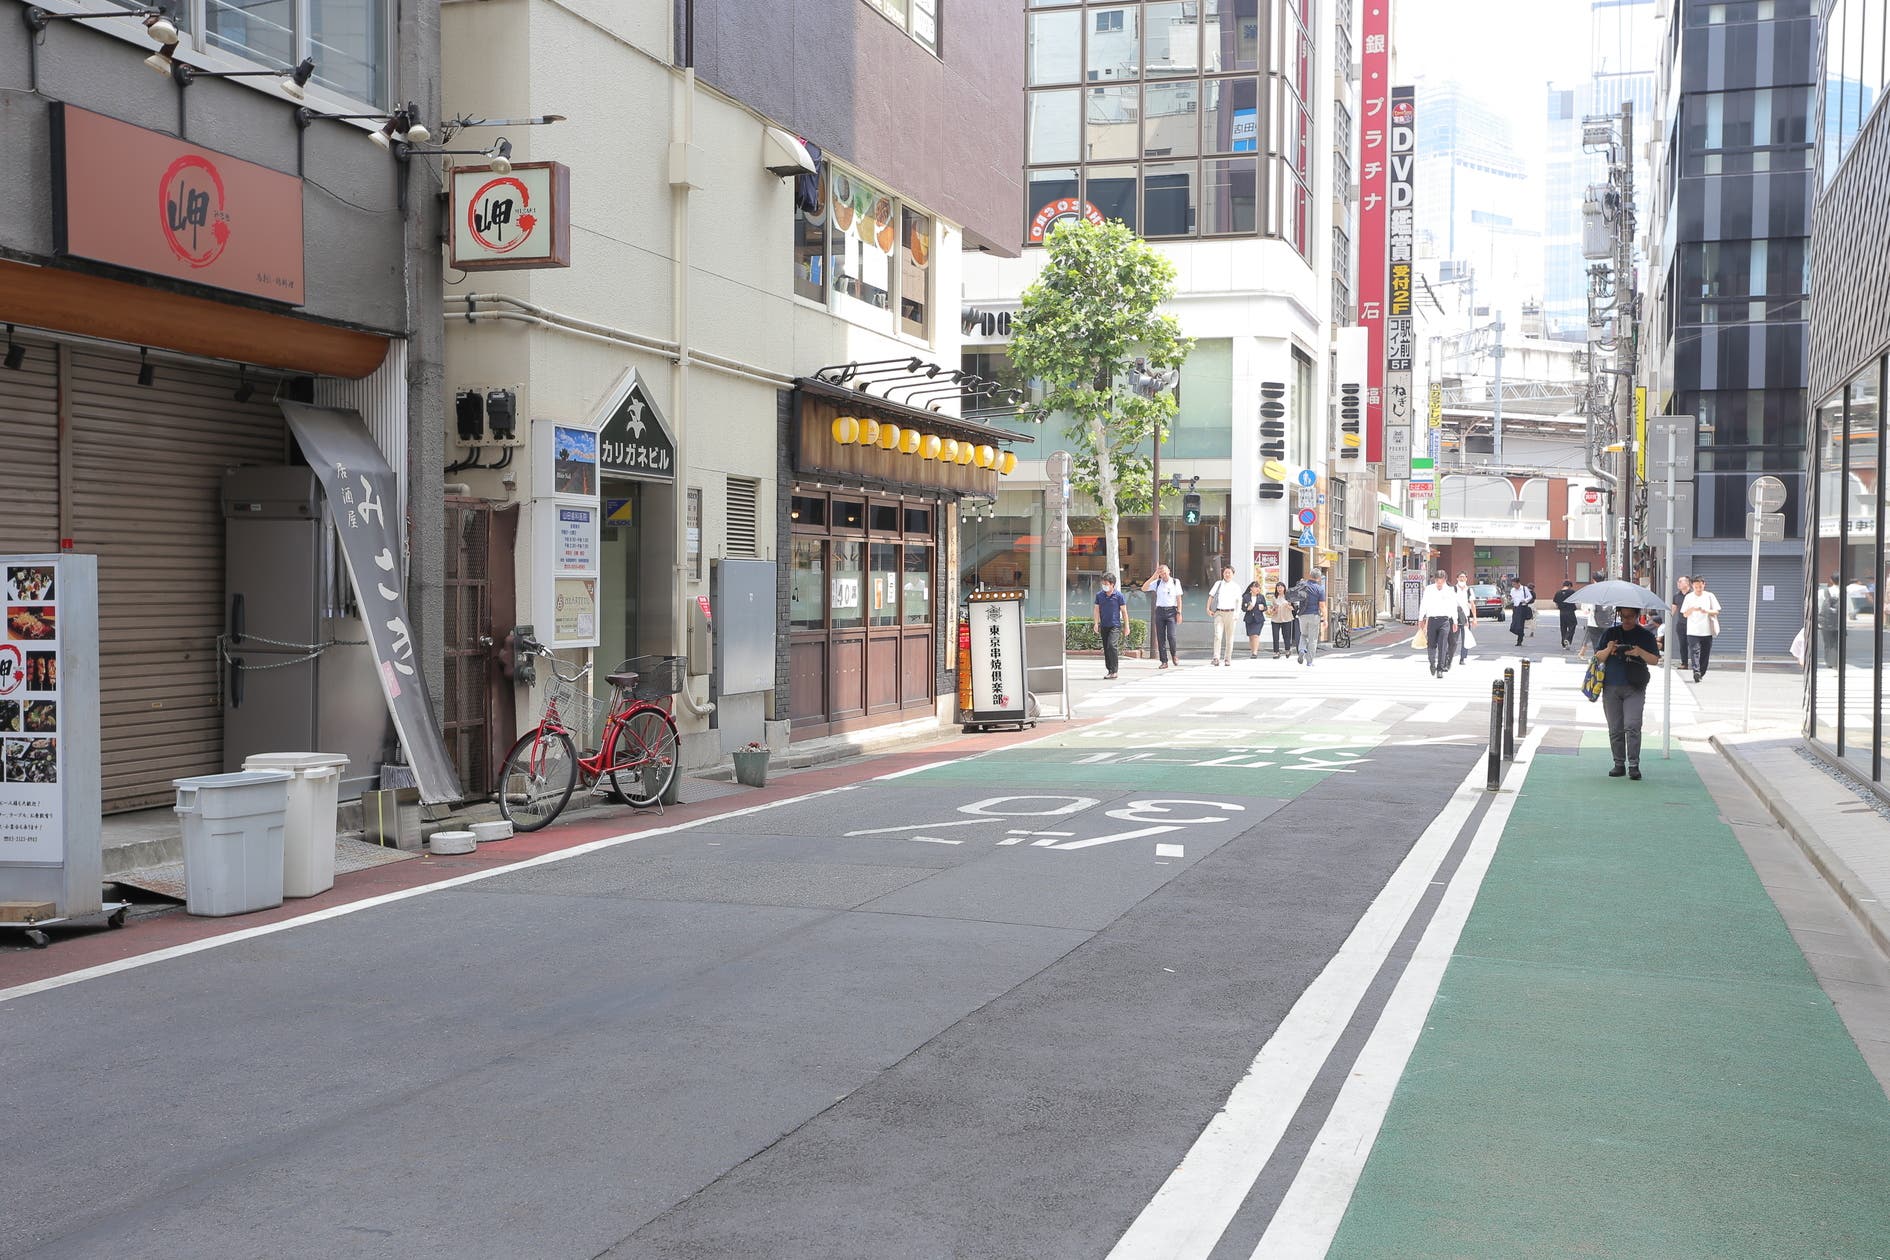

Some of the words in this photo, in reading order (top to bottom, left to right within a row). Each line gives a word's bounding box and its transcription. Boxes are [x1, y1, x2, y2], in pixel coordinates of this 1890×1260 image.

[474, 198, 514, 242] 岬
[1391, 360, 1409, 370] 5F
[1391, 384, 1407, 418] ねぎし
[601, 439, 670, 471] カリガネビル
[335, 461, 359, 529] 居酒屋
[1431, 521, 1459, 533] 神田駅
[989, 625, 1004, 705] 東京串焼倶楽部
[957, 795, 1246, 823] 30
